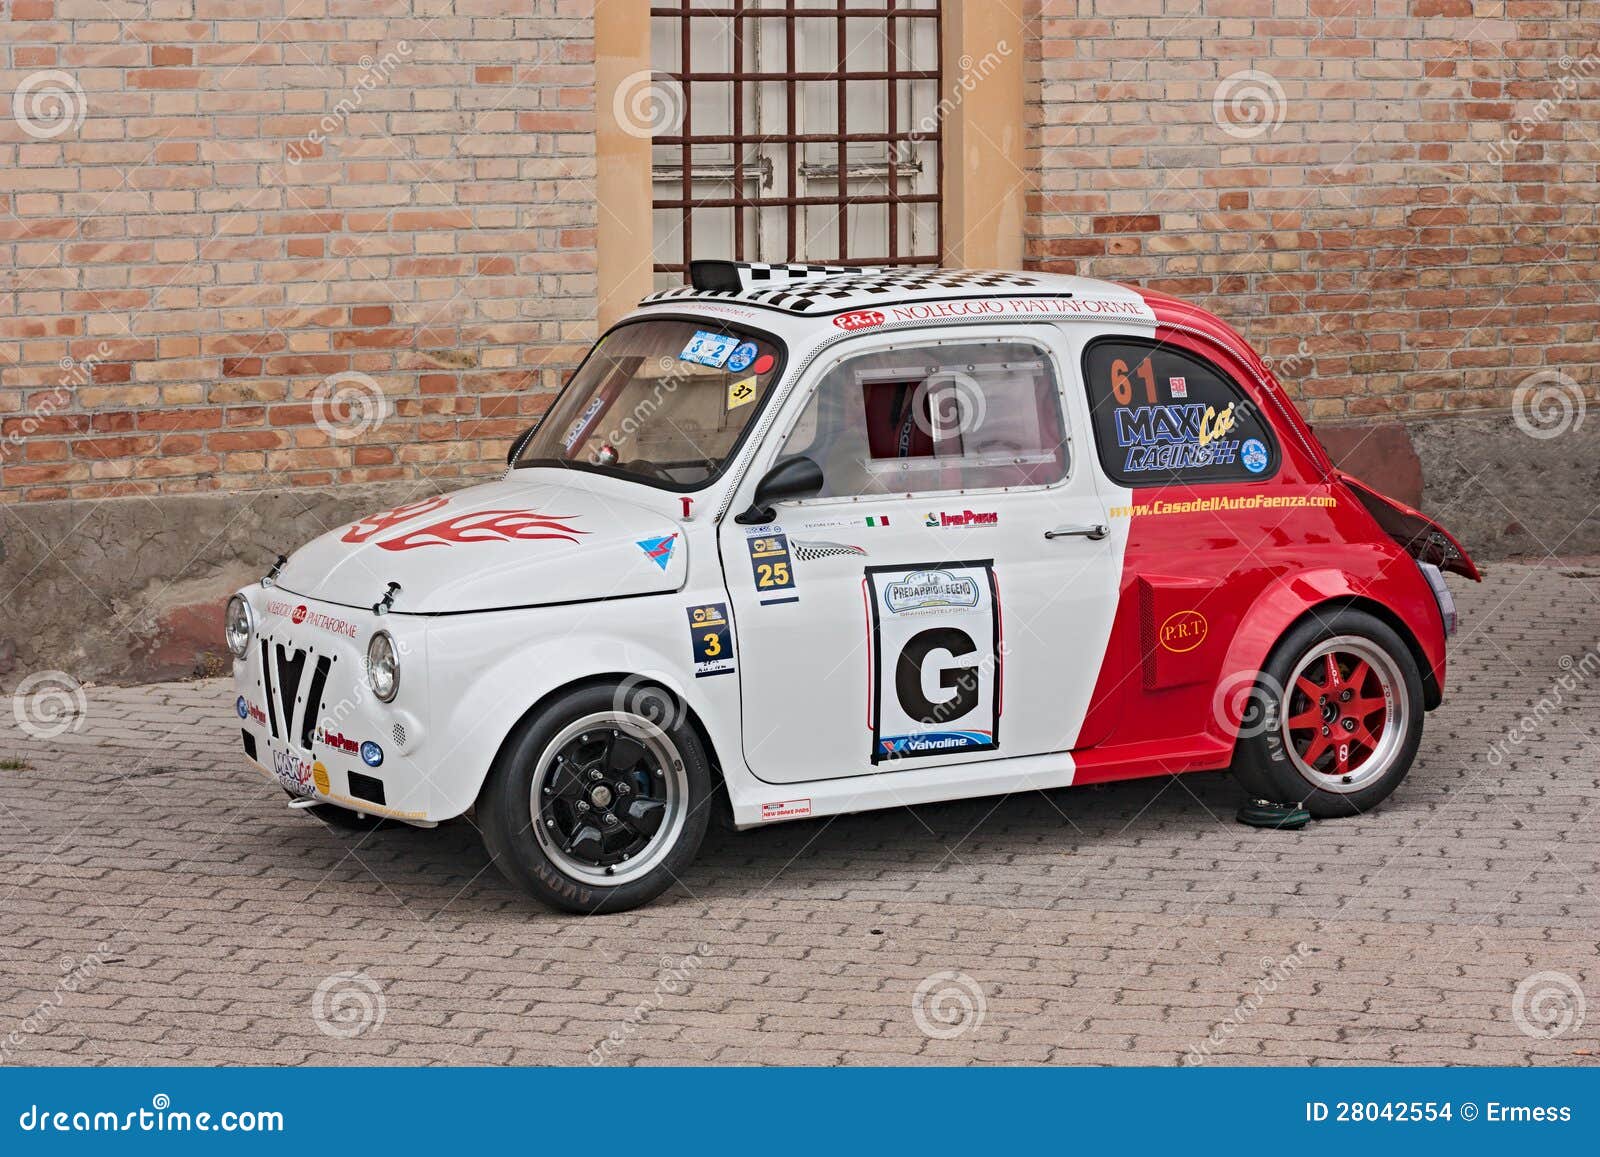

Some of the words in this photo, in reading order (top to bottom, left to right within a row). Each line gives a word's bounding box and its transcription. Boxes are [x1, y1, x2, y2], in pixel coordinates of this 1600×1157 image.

[893, 300, 1004, 320] NOLEGGIO
[1010, 298, 1145, 316] PIATTAFORME
[691, 340, 704, 353] 3
[712, 344, 726, 358] 2
[733, 385, 753, 399] 37
[1111, 358, 1158, 405] 61
[757, 562, 789, 587] 25
[1165, 620, 1205, 640] P.R.T.
[704, 633, 721, 656] 3
[896, 628, 980, 724] G
[909, 737, 969, 751] Valvoline
